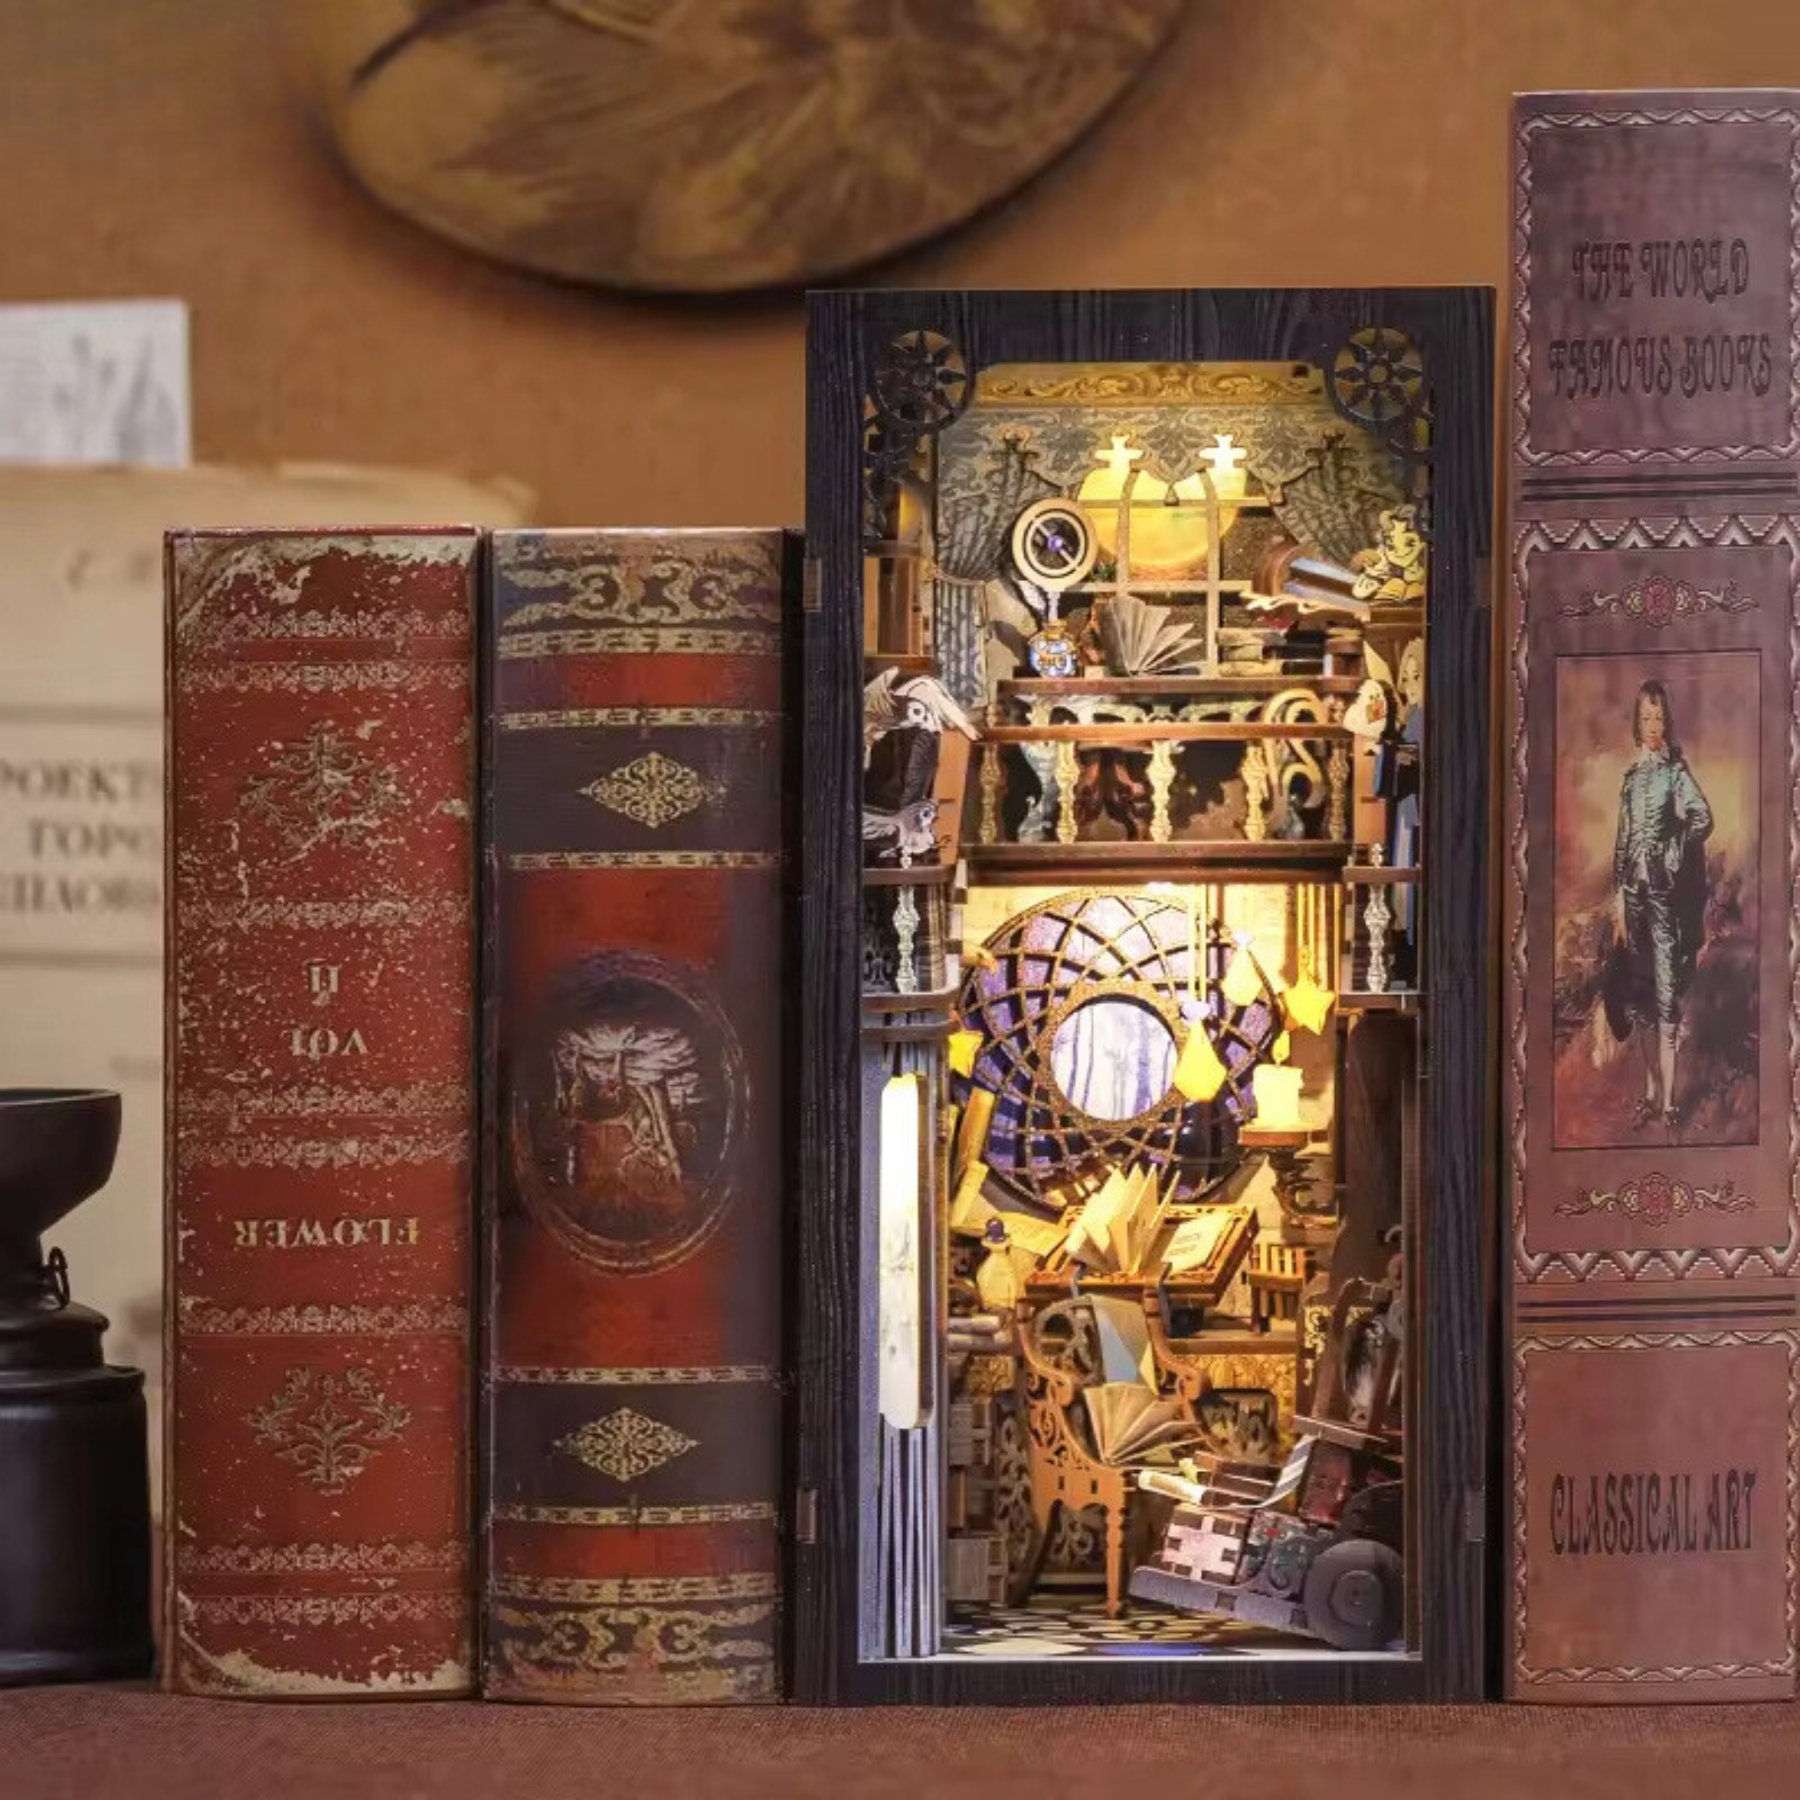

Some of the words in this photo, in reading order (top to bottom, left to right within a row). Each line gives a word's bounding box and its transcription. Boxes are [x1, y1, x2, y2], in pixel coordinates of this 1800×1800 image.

[1571, 239, 1635, 302] THE
[1640, 238, 1750, 303] WORLD
[1679, 332, 1773, 398] BOOKS
[288, 1025, 369, 1061] VOL
[233, 1217, 420, 1249] FLOWER
[1550, 1472, 1698, 1556] CLASSICAL
[1703, 1467, 1757, 1552] ART
